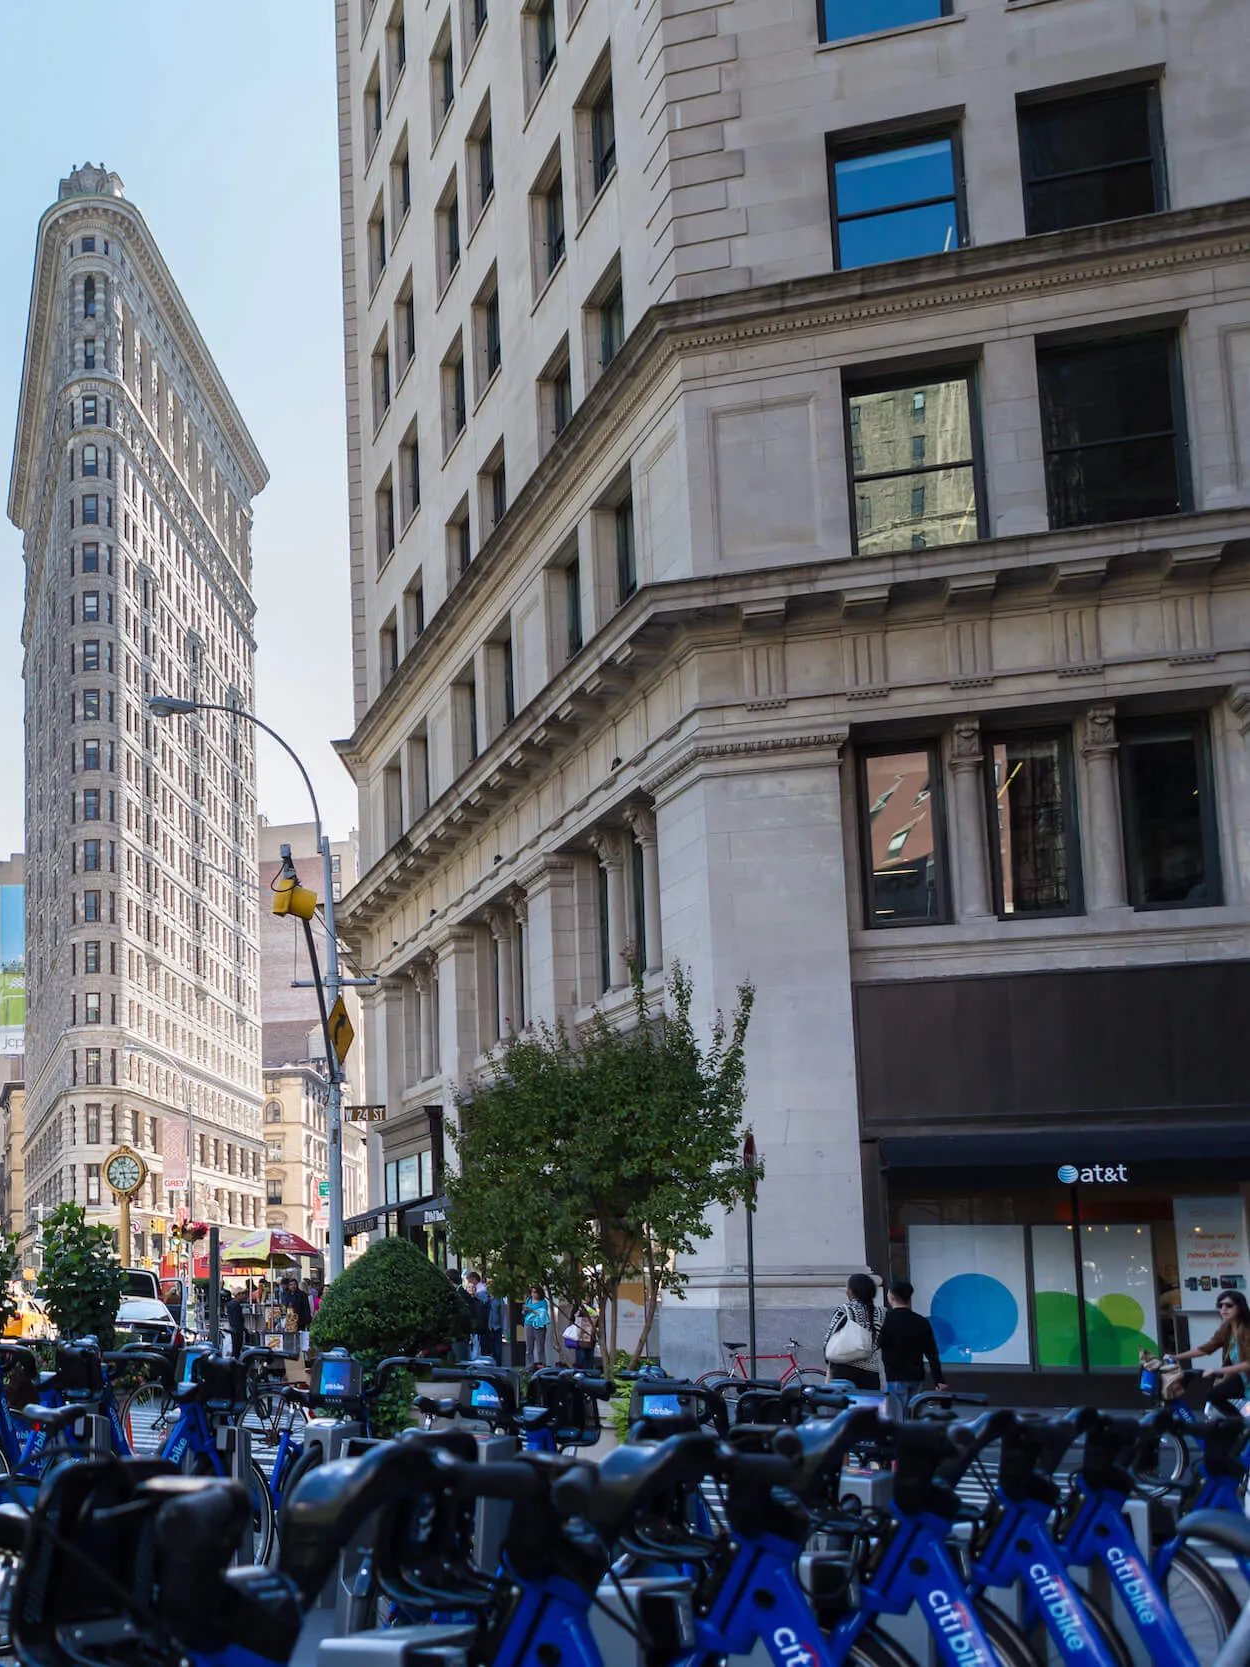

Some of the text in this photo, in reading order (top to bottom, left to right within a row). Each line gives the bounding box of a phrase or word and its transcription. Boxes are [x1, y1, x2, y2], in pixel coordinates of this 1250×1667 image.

[346, 1108, 383, 1121] W 24 ST
[1080, 1164, 1128, 1183] at&t
[168, 1437, 188, 1464] bike
[774, 1627, 816, 1667] cit
